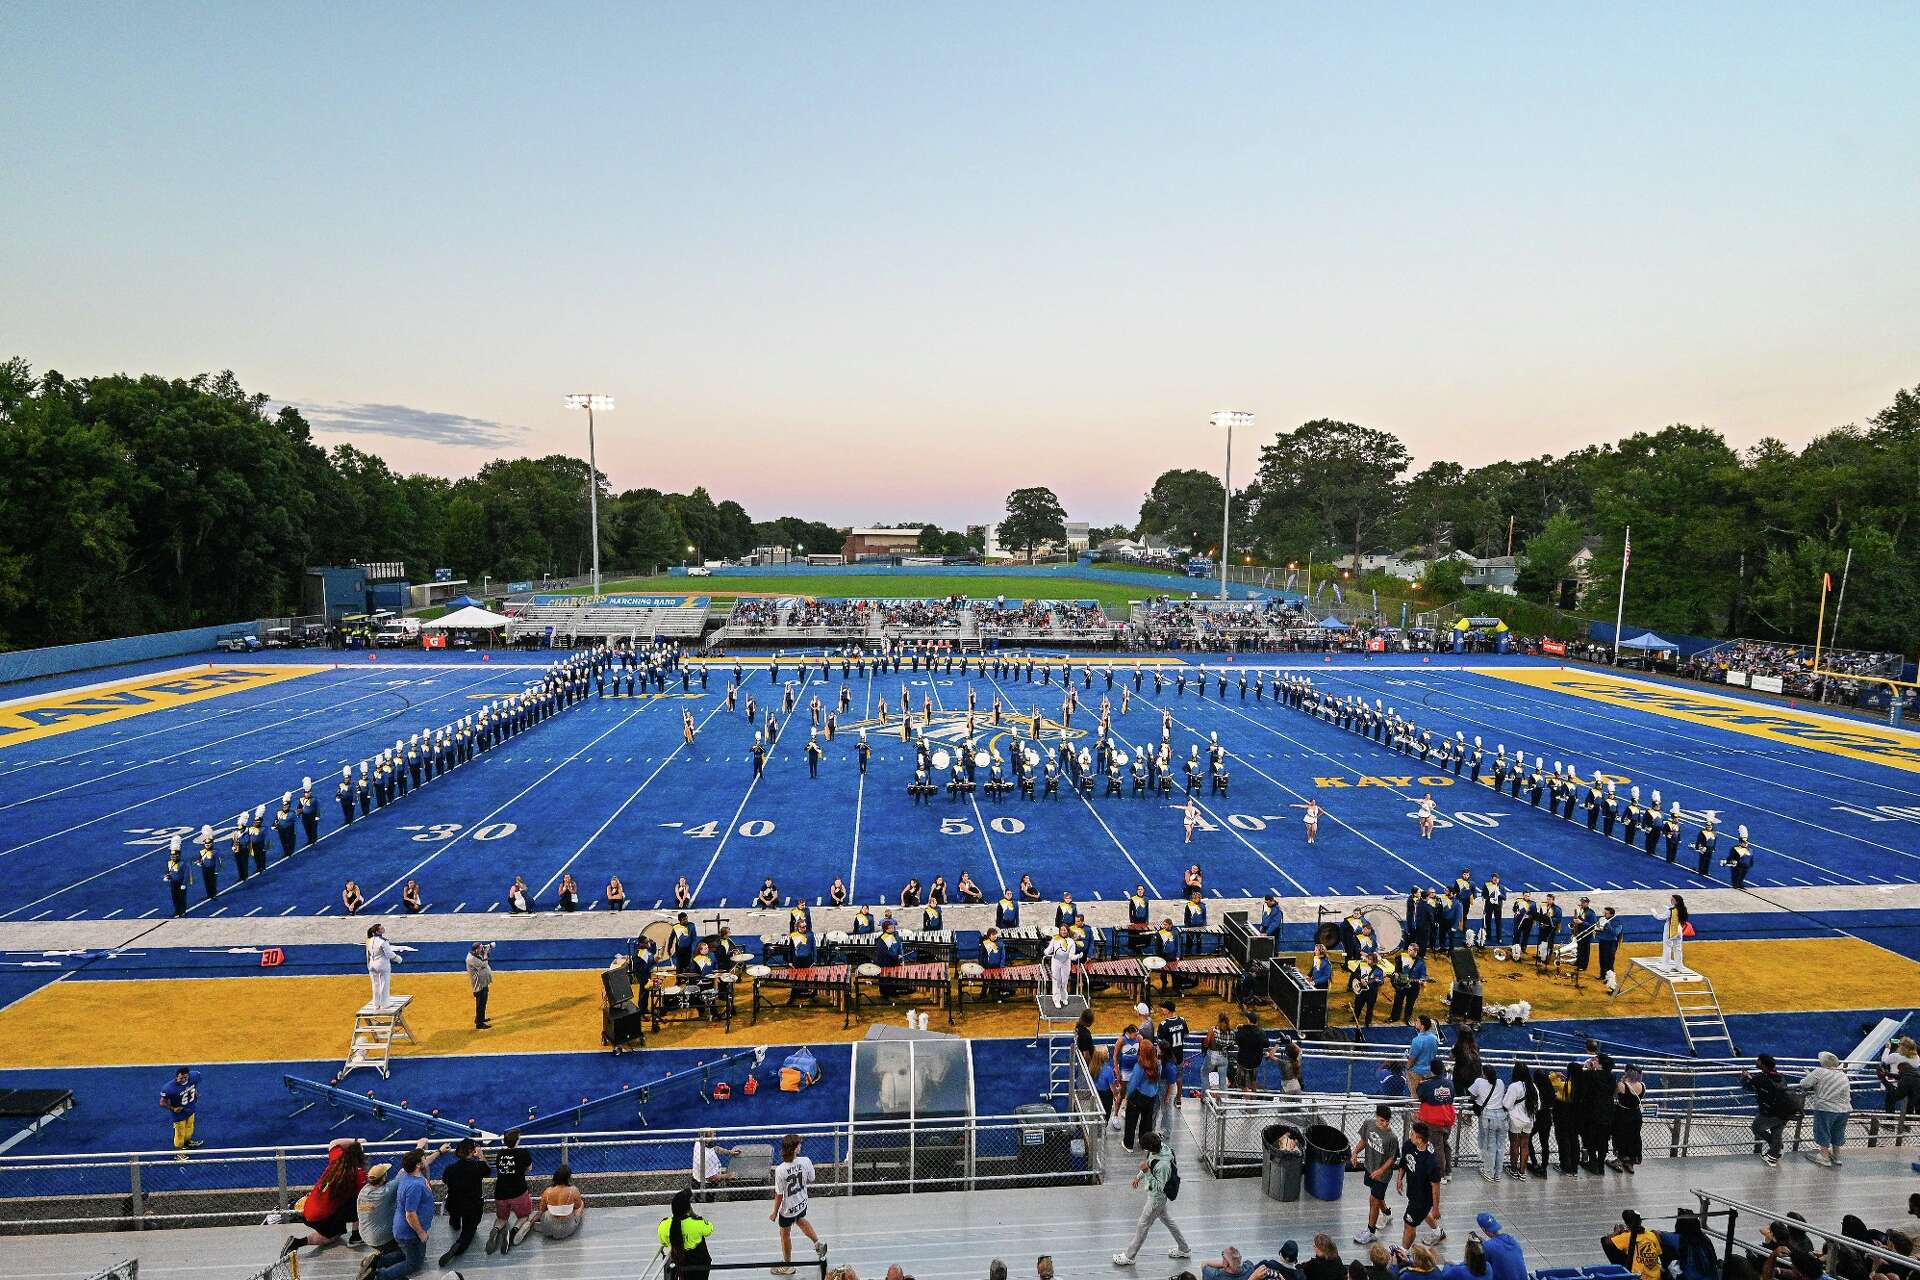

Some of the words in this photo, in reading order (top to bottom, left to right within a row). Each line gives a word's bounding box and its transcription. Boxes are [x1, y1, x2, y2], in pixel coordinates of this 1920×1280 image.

[0, 670, 277, 735] AVEN
[1312, 776, 1455, 788] KAYO
[411, 823, 518, 841] 30
[683, 820, 775, 838] 40
[940, 817, 1025, 834] 50
[262, 950, 279, 965] 30
[1172, 1032, 1182, 1047] 11
[786, 1171, 804, 1197] 21
